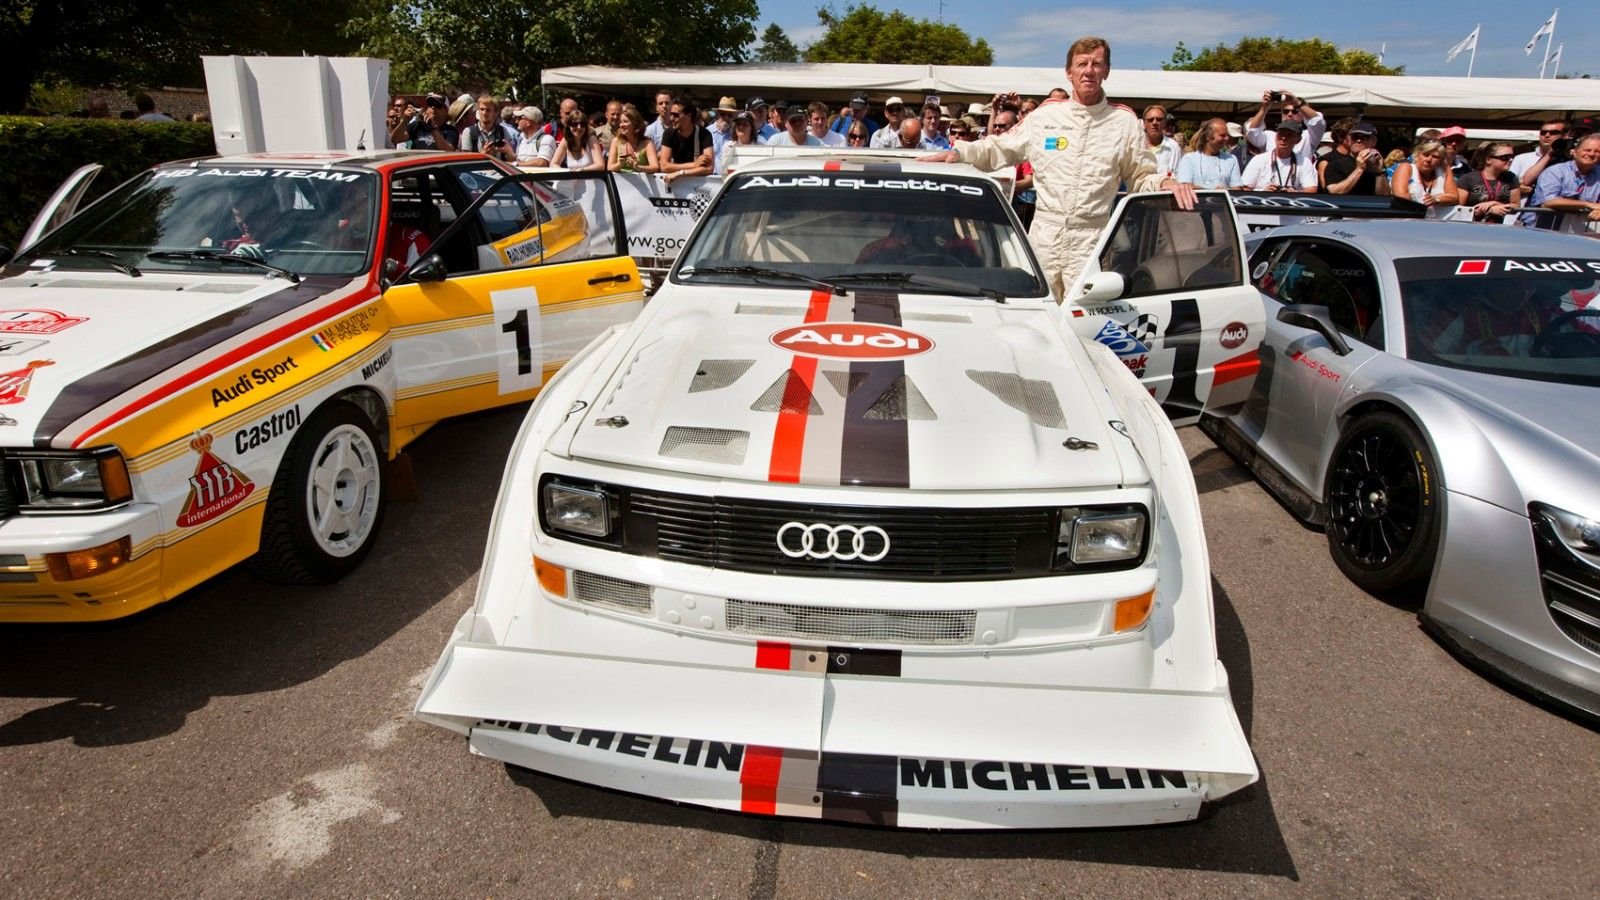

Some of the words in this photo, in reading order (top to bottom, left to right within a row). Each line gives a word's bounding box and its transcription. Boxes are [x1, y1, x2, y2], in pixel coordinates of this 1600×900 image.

[153, 168, 199, 180] HB
[200, 168, 266, 178] Audi
[271, 168, 361, 183] TEAM
[739, 175, 830, 190] Audi
[834, 179, 984, 196] quattro
[1504, 260, 1584, 273] Audi
[335, 311, 369, 333] MOUTON
[1221, 327, 1247, 342] Audi
[502, 309, 532, 376] 1
[780, 329, 920, 350] Audi
[1300, 355, 1318, 370] Audi
[1317, 364, 1341, 383] Sport
[211, 374, 255, 408] Audi
[251, 356, 299, 383] Sport
[235, 404, 301, 455] Castrol
[188, 462, 235, 508] HB
[187, 488, 247, 525] international
